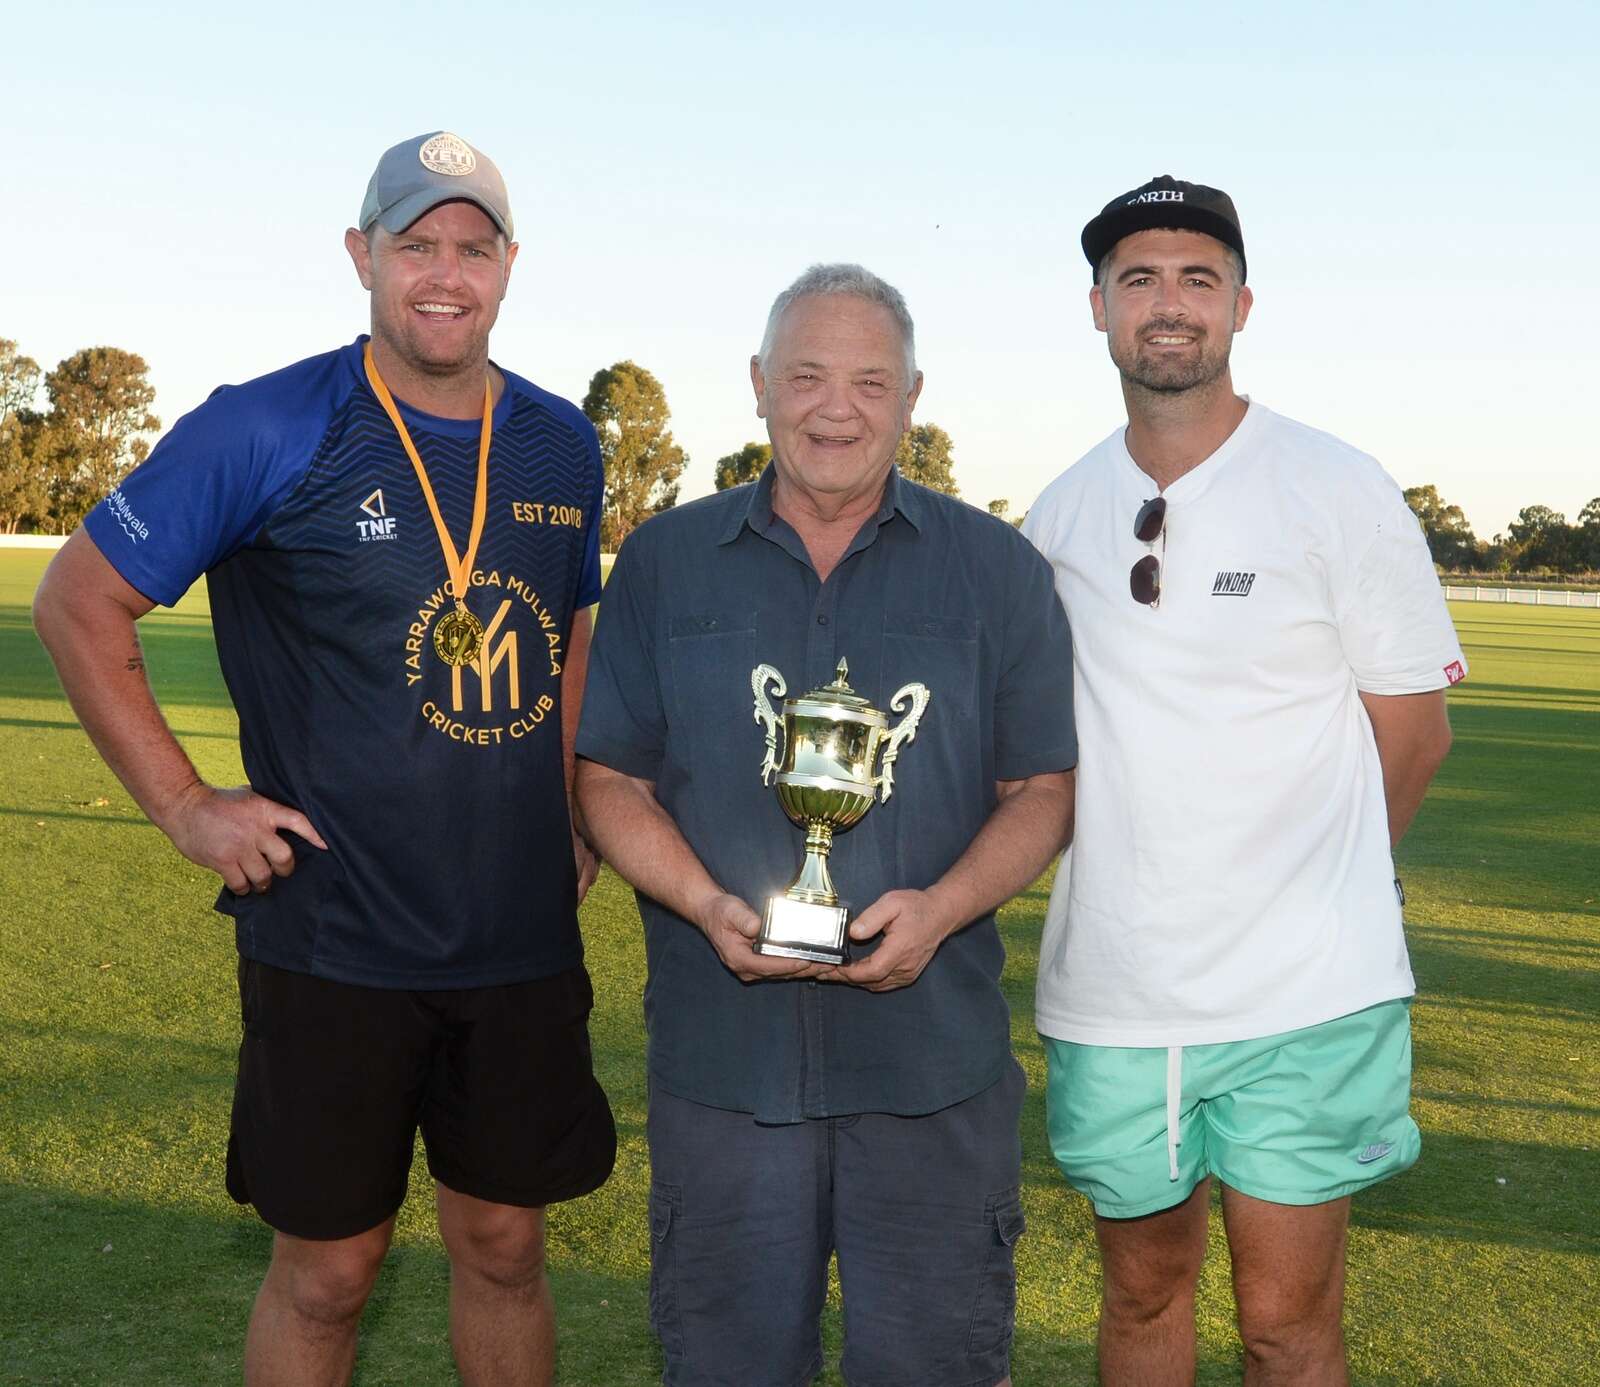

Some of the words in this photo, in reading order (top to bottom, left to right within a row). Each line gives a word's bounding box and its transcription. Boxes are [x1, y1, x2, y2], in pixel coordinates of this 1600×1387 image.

[422, 149, 472, 168] YETI
[355, 517, 396, 538] TNF
[512, 502, 544, 524] EST
[548, 504, 582, 529] 2008
[1212, 571, 1256, 593] WNDRR
[405, 570, 502, 687] YARRAWOGA
[506, 575, 562, 677] MULWALA
[421, 701, 504, 745] CRICKET
[509, 694, 554, 739] CLUB
